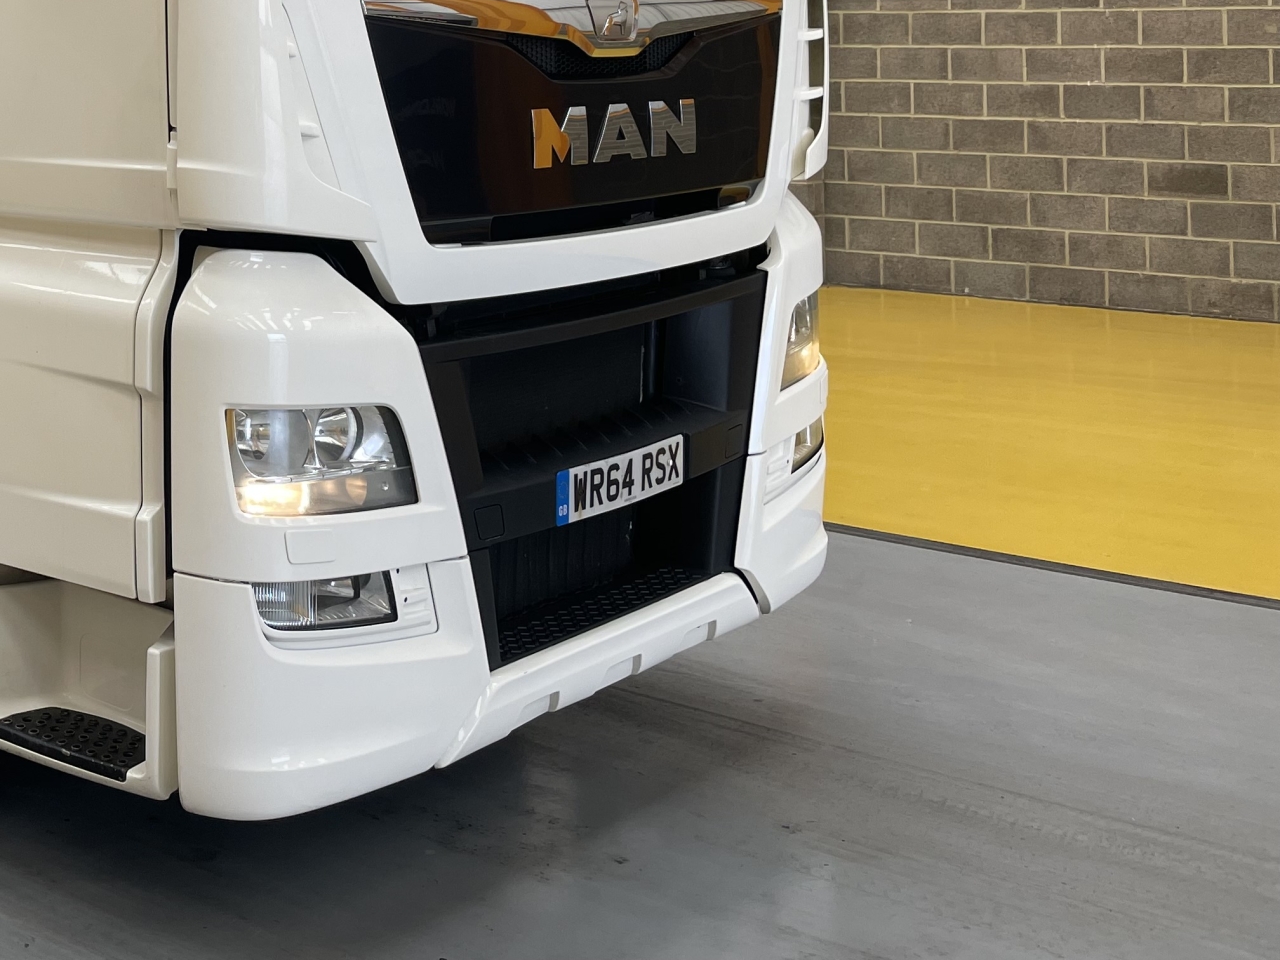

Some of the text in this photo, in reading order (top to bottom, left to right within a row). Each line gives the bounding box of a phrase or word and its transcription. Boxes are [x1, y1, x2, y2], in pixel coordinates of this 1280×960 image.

[531, 98, 697, 169] MAN
[558, 504, 568, 517] GB
[574, 441, 680, 513] WR64 RSX
